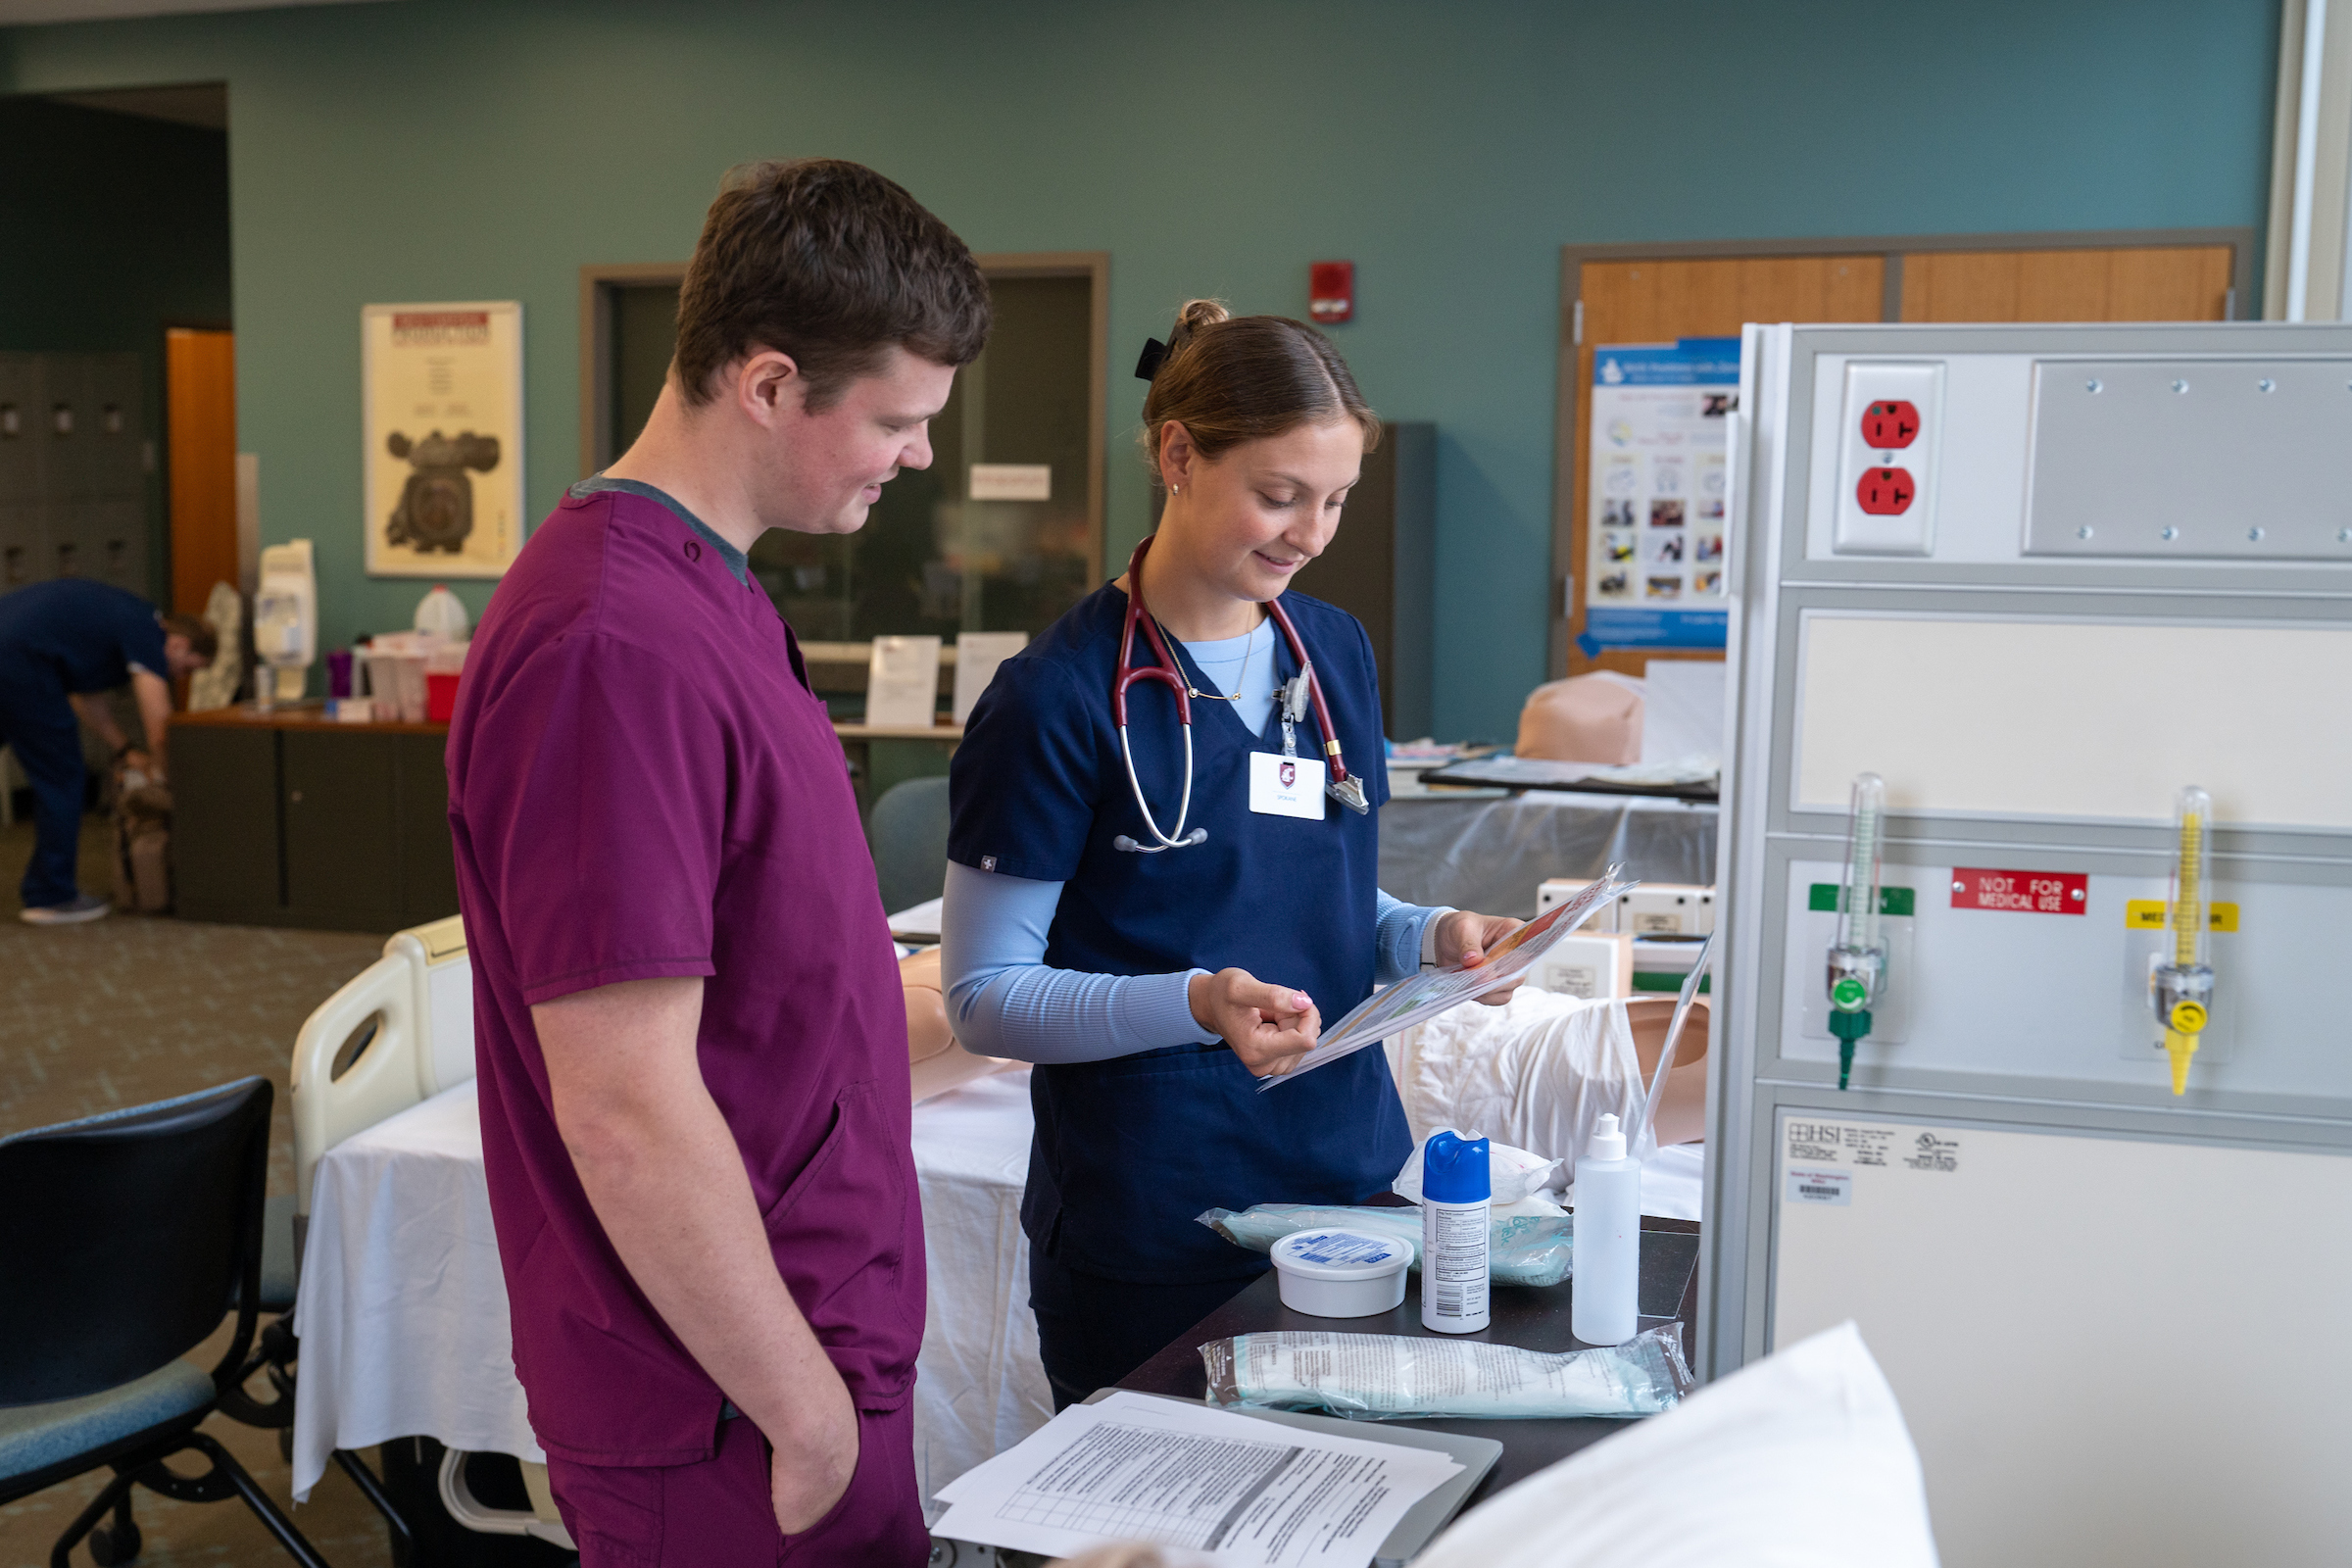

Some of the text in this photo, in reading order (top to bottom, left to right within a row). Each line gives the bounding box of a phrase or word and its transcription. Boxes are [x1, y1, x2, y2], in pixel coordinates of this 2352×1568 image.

[1979, 877, 2064, 896] NOT FOR
[1978, 892, 2063, 912] MEDICAL USE
[1810, 1124, 1840, 1144] HSI
